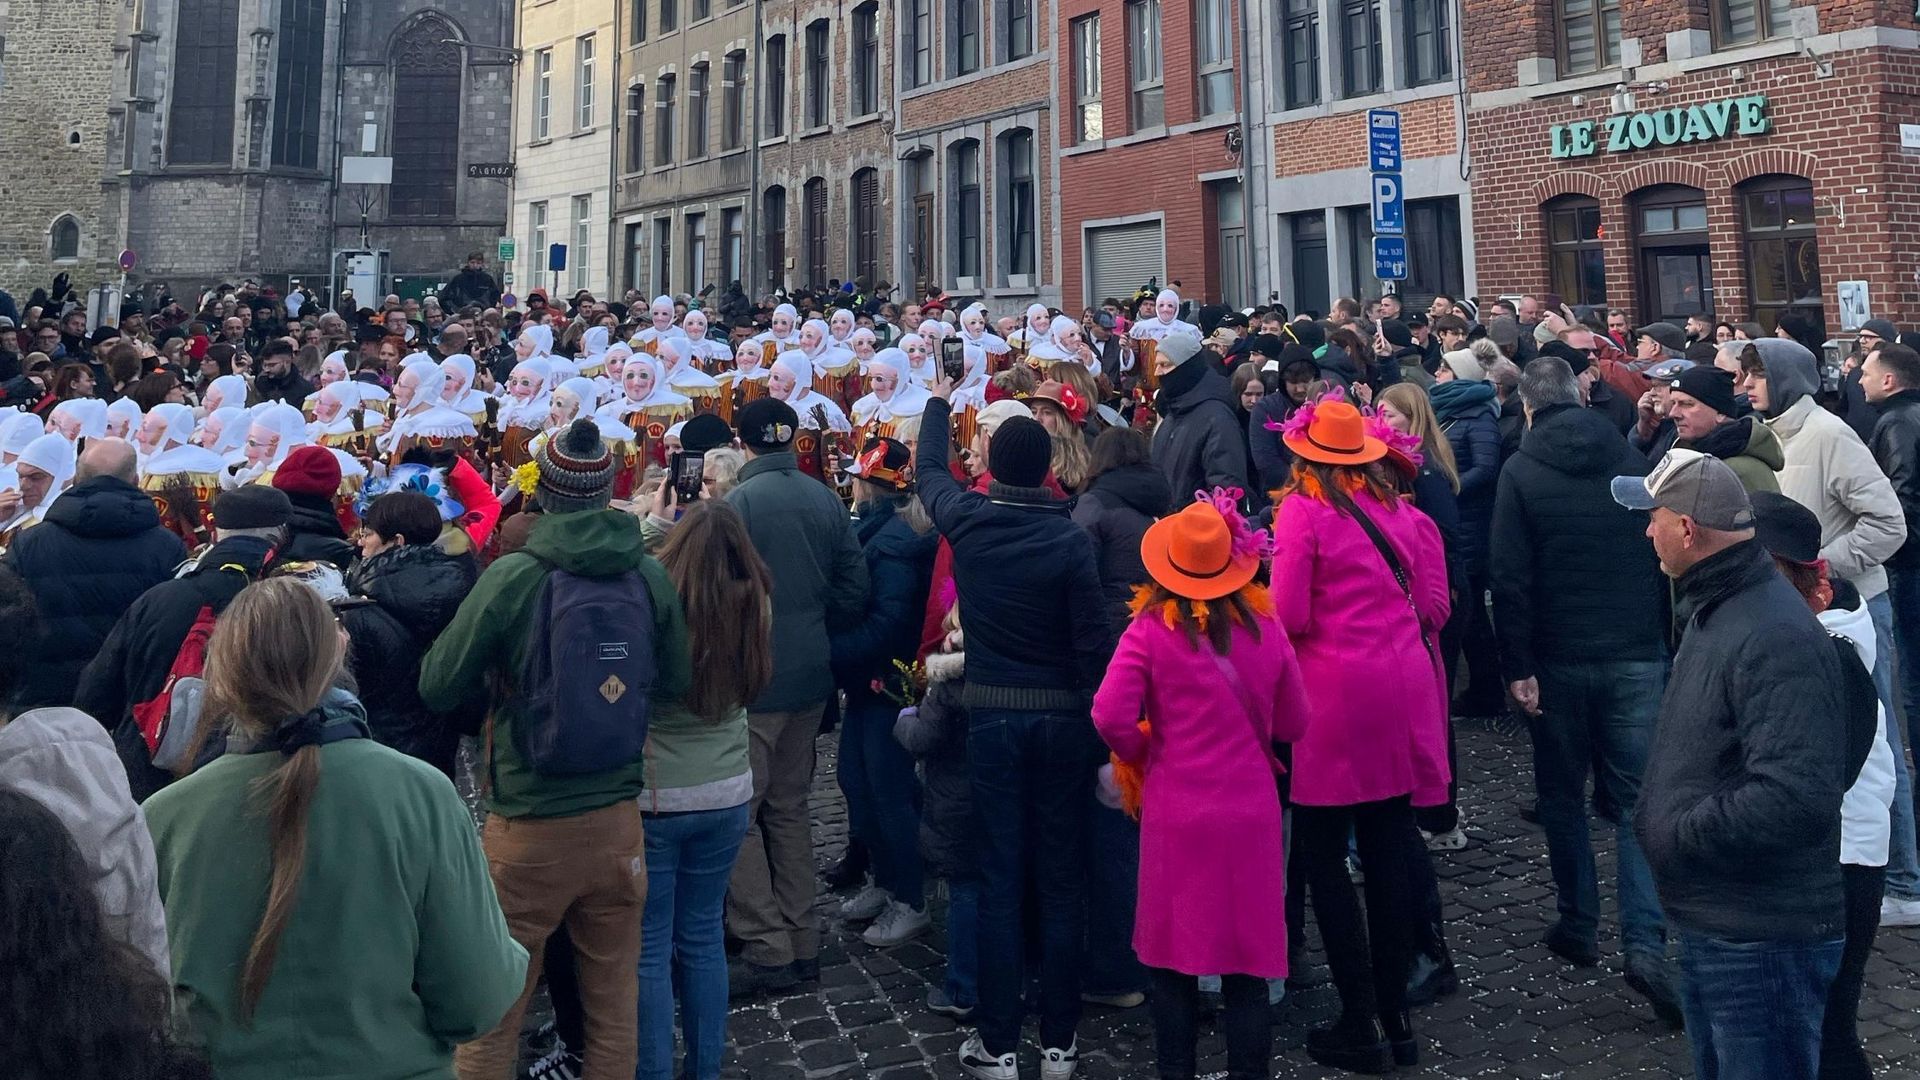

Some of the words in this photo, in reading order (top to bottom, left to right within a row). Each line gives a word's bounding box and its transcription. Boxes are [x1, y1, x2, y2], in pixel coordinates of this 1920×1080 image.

[1550, 120, 1595, 158] LE
[1604, 96, 1771, 152] ZOUAVE
[1375, 177, 1397, 221] P
